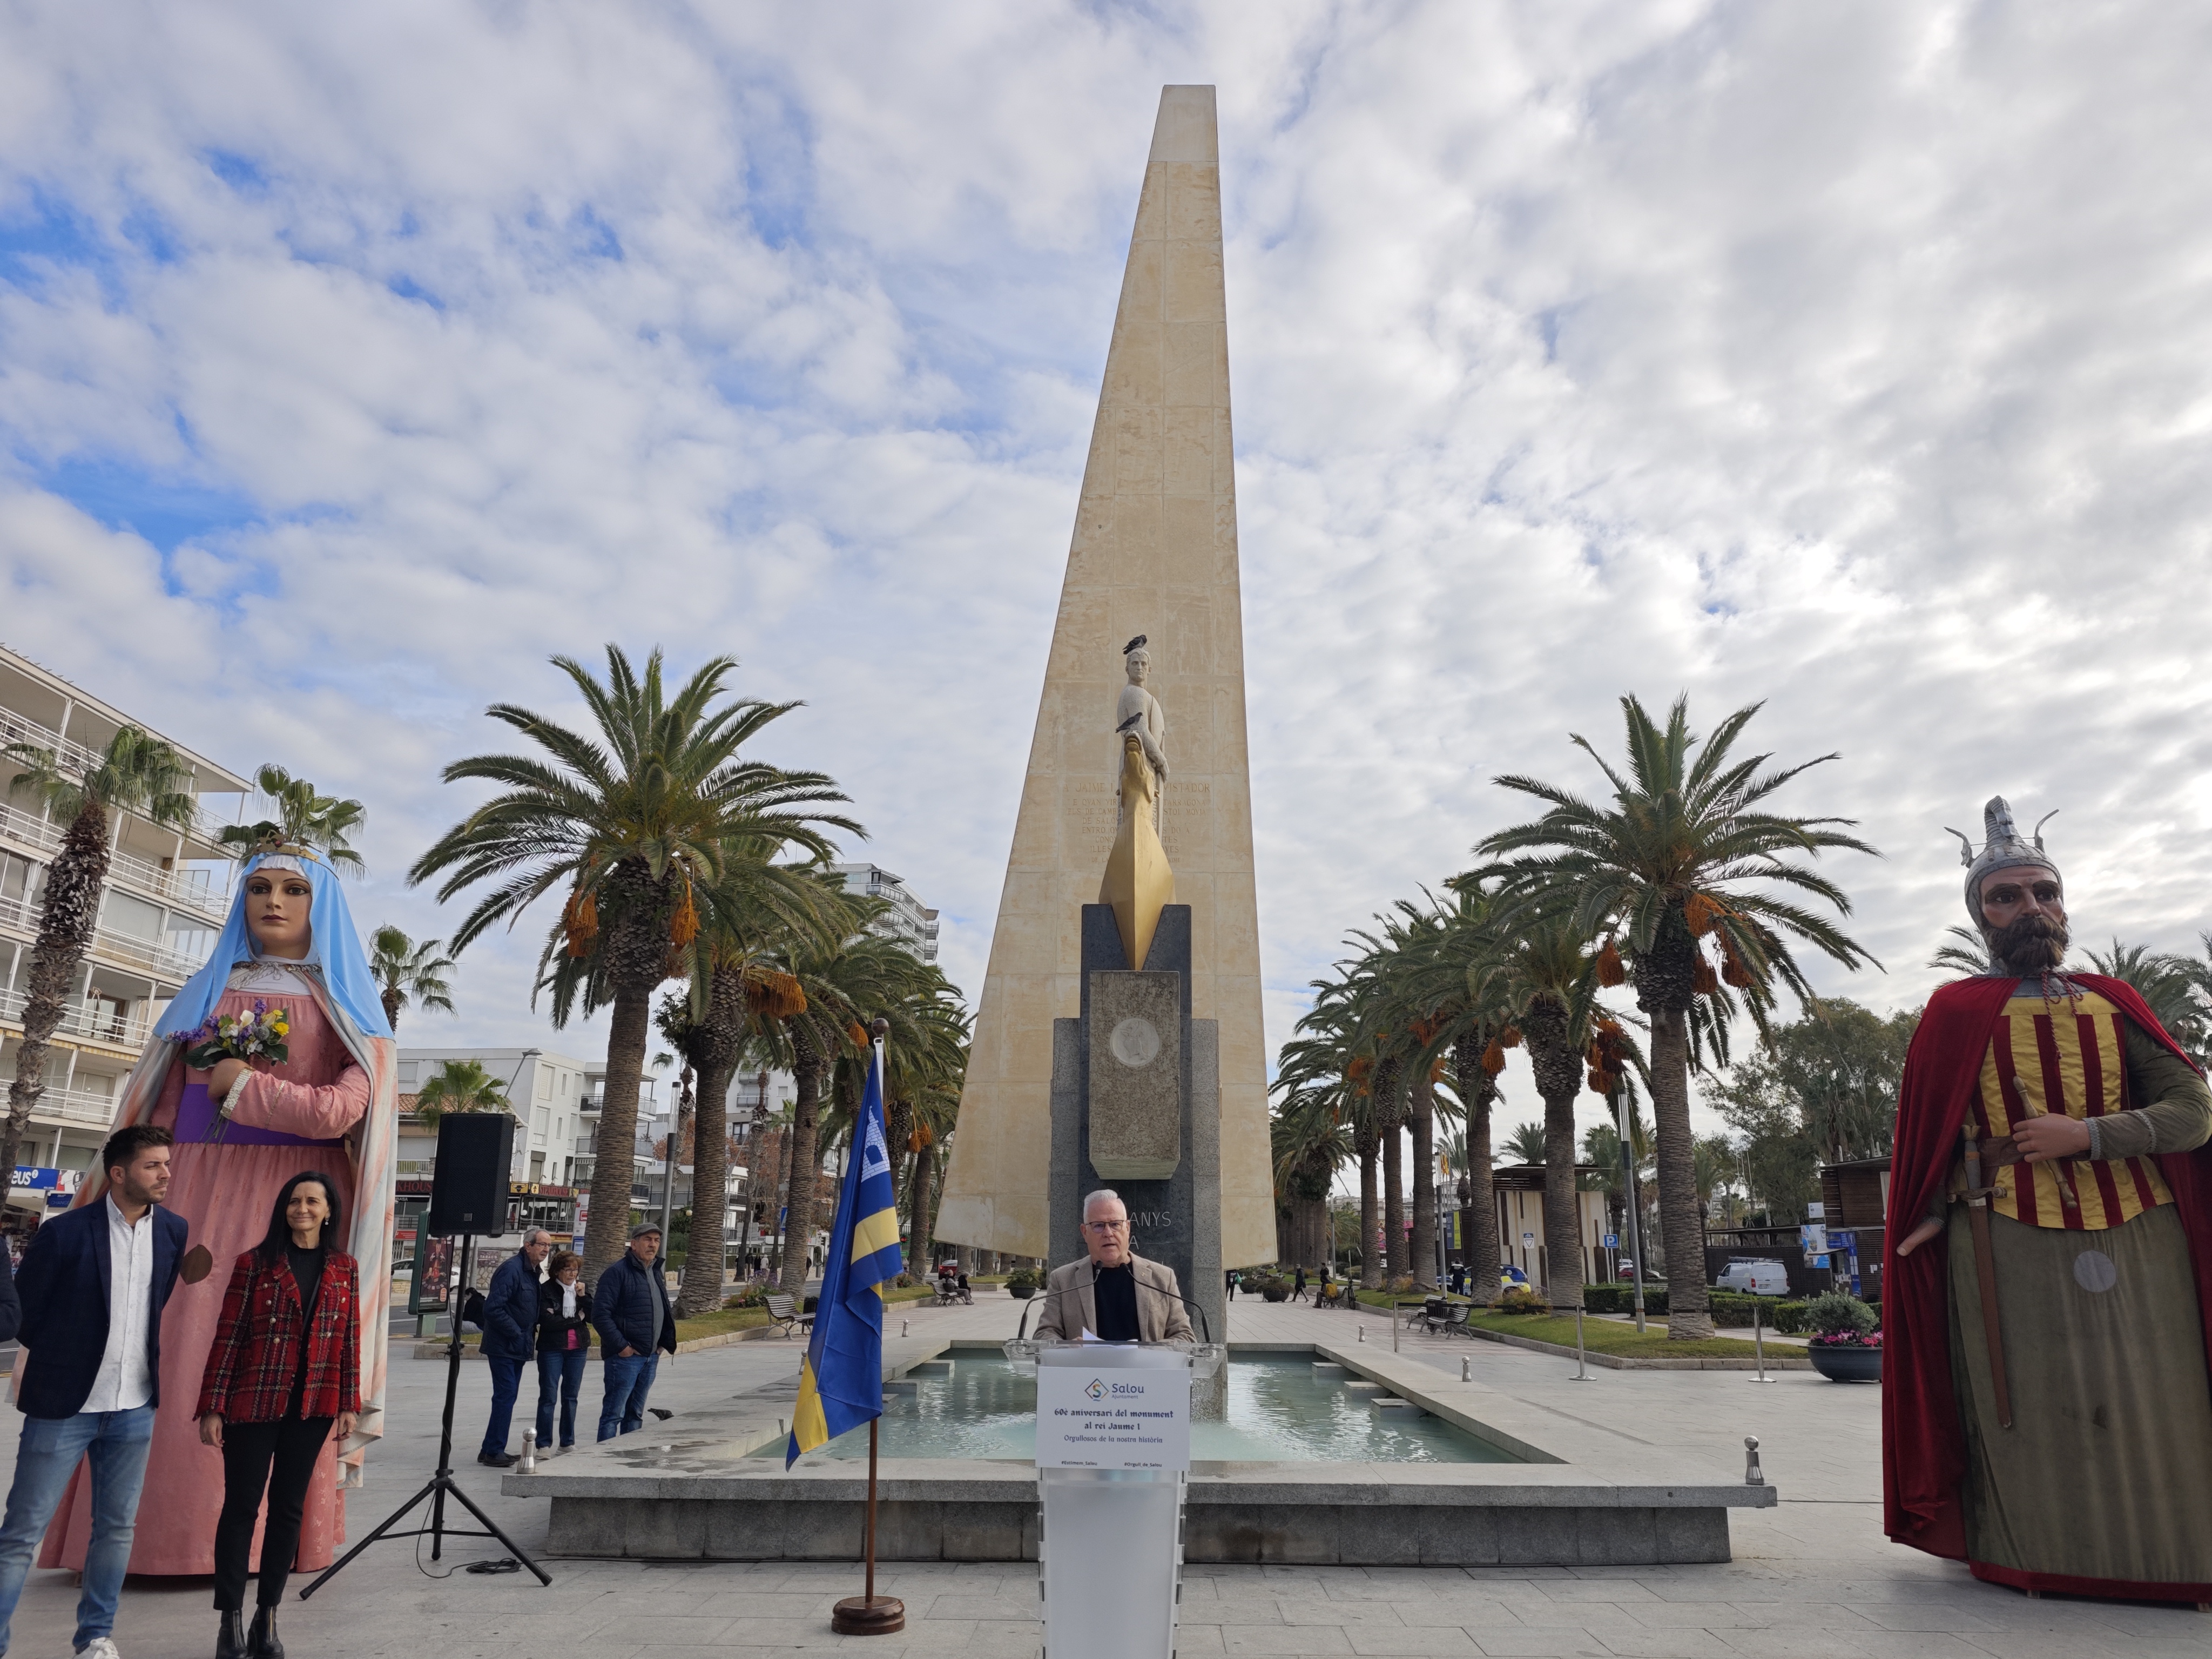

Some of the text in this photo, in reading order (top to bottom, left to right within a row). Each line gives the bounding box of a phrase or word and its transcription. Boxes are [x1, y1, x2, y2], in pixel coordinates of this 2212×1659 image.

[397, 1182, 432, 1192] KHOUS
[540, 1185, 569, 1197] STEAKHOUSE
[1129, 1212, 1171, 1227] ANYS
[1606, 1236, 1615, 1247] P
[1112, 1383, 1144, 1393] Salou
[1115, 1409, 1127, 1417] del
[1084, 1421, 1092, 1429] al
[1064, 1434, 1097, 1443] Orgullosos
